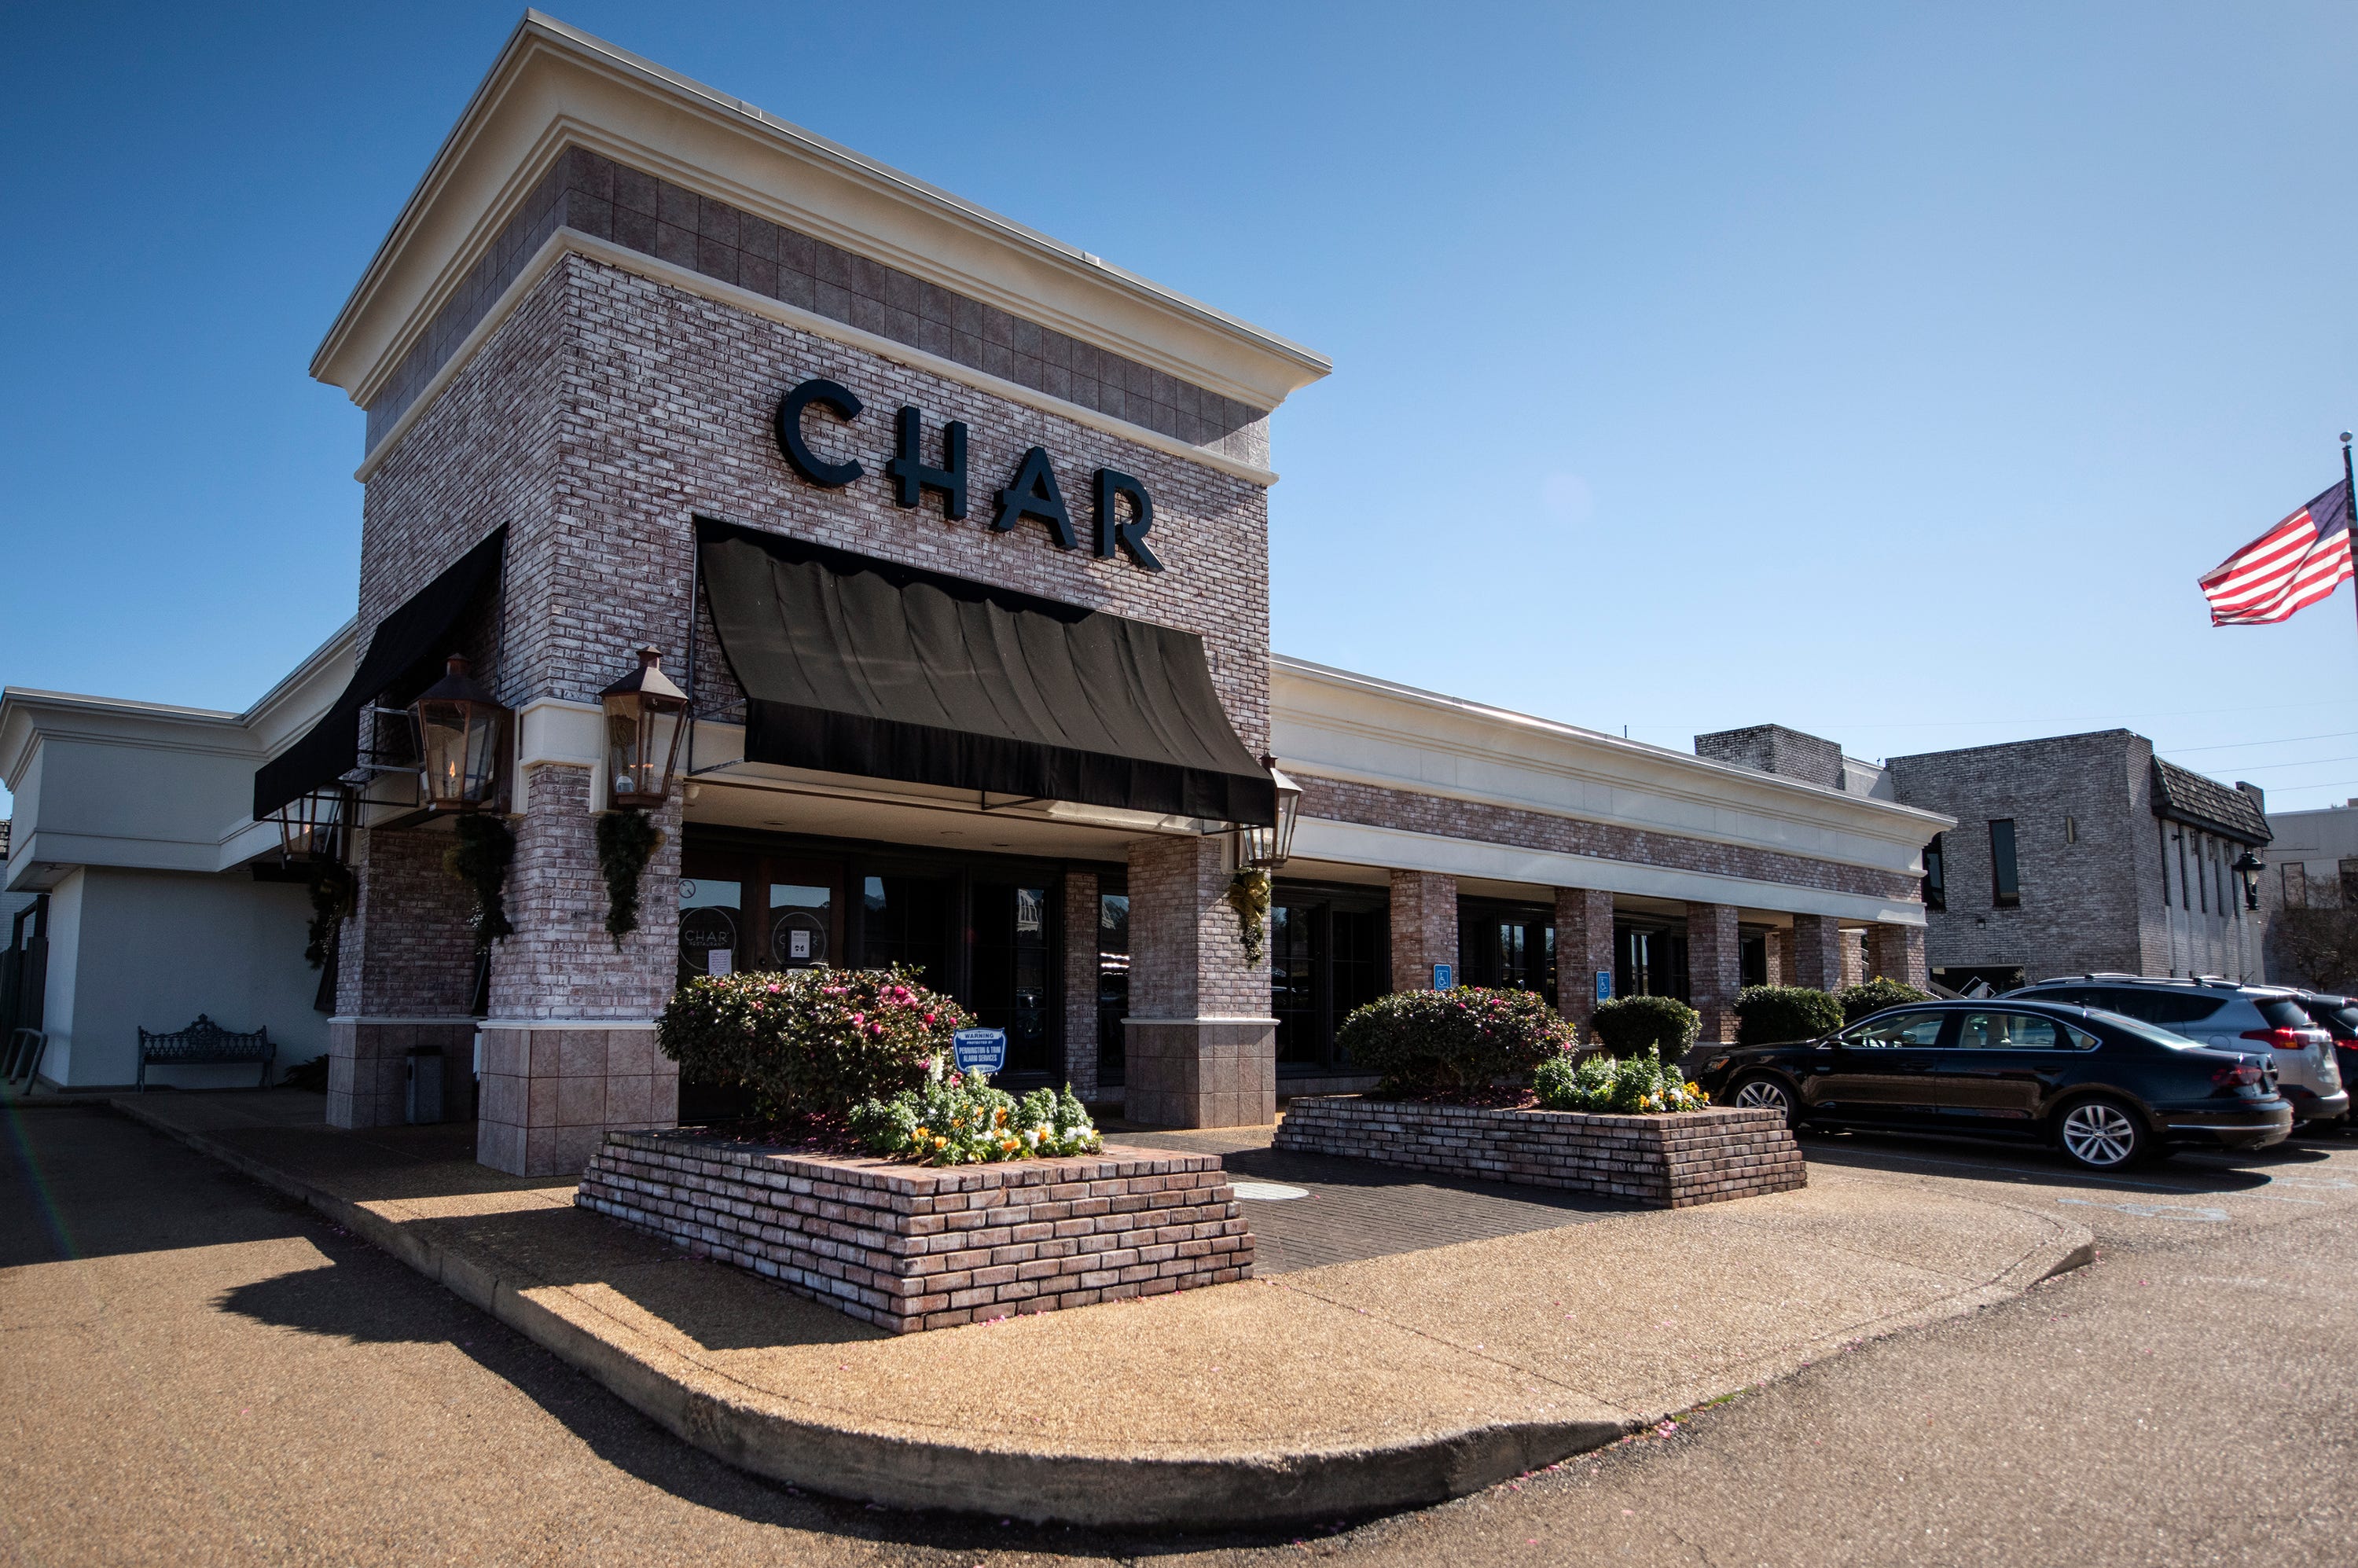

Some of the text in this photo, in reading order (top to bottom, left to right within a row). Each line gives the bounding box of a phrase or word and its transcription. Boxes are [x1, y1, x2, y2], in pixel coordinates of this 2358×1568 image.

[775, 379, 1165, 573] CHAR
[685, 930, 728, 943] CHAR
[959, 1046, 986, 1055] PENNINGTON
